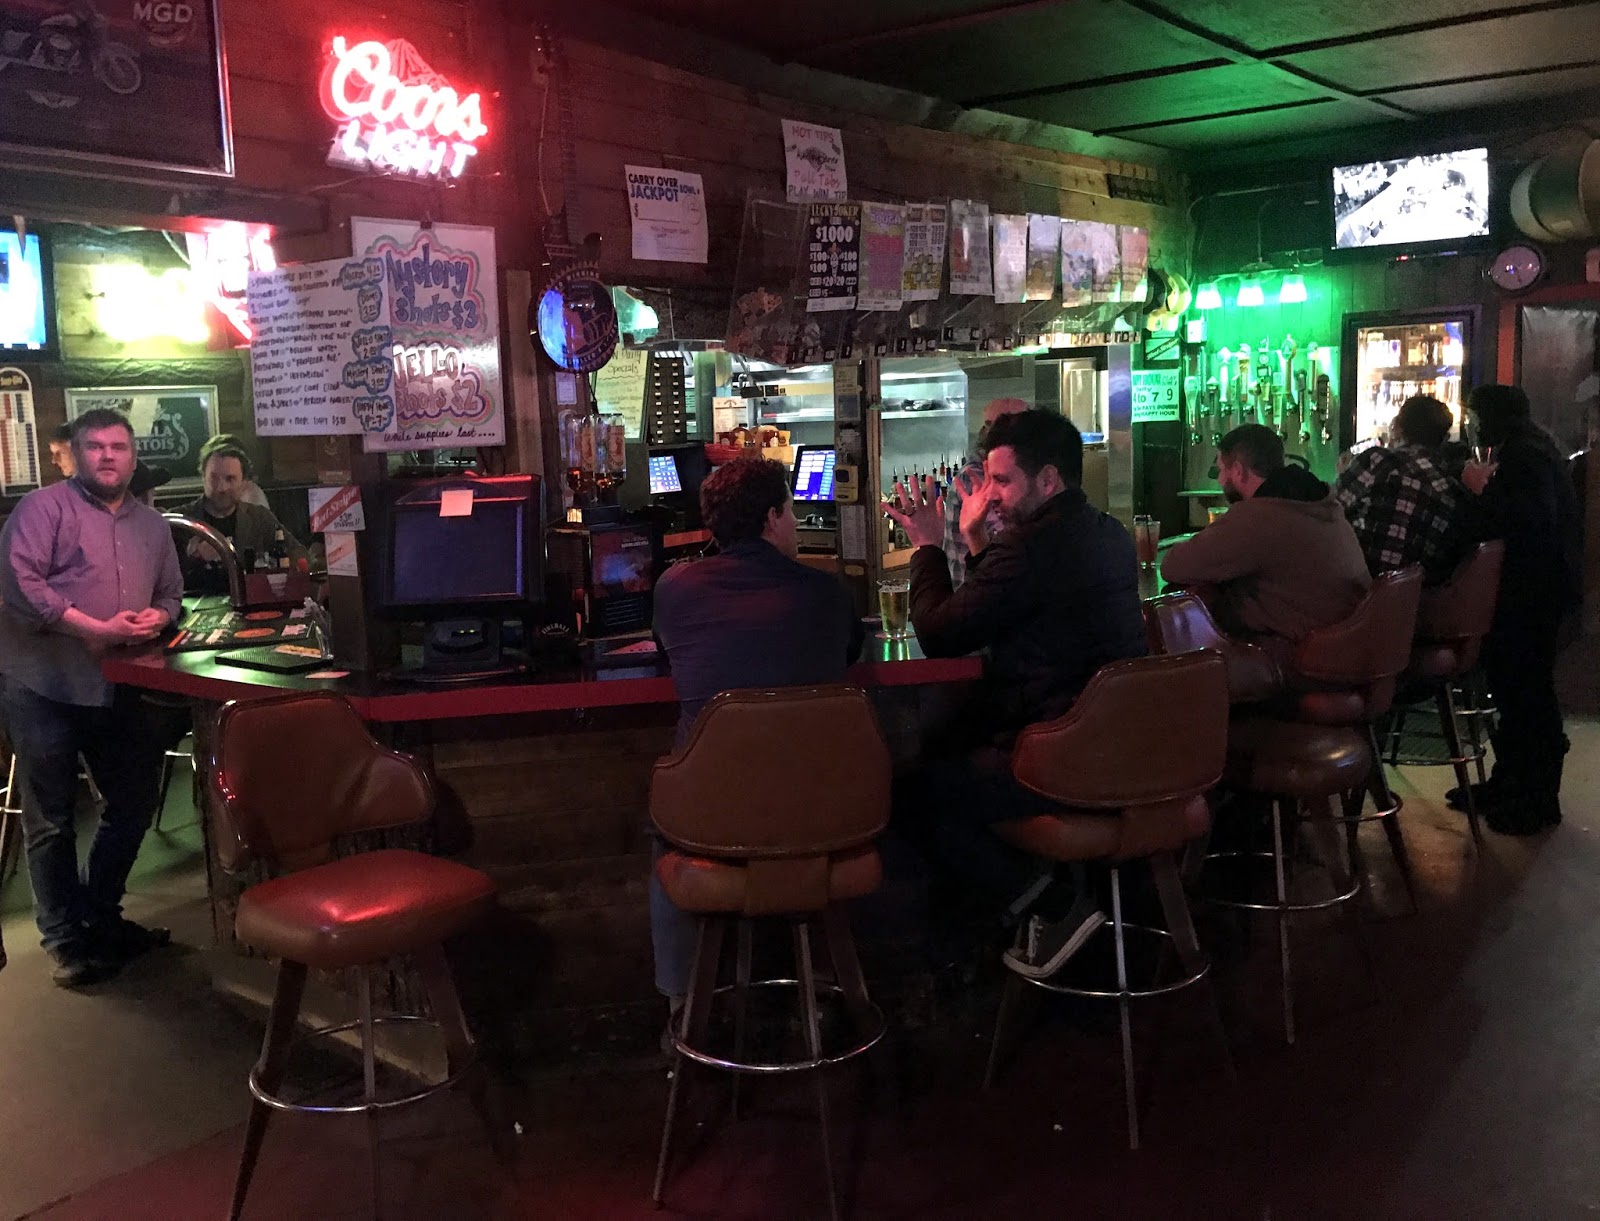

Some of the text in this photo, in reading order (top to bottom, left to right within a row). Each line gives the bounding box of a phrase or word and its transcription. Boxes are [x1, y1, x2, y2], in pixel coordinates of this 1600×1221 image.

[132, 2, 194, 24] MGD
[326, 36, 488, 140] Coors
[334, 120, 477, 178] LIGHT
[628, 173, 678, 188] CARRY OVER
[630, 184, 679, 202] JACKPOT
[788, 184, 809, 197] PLAY
[813, 187, 829, 200] WIN
[816, 225, 854, 243] $1000
[809, 262, 828, 273] $100
[840, 262, 858, 272] $100
[607, 363, 640, 376] Specials
[1151, 391, 1160, 403] 7
[1166, 388, 1174, 401] 9
[415, 429, 452, 442] supplies
[135, 437, 175, 451] RTOIS
